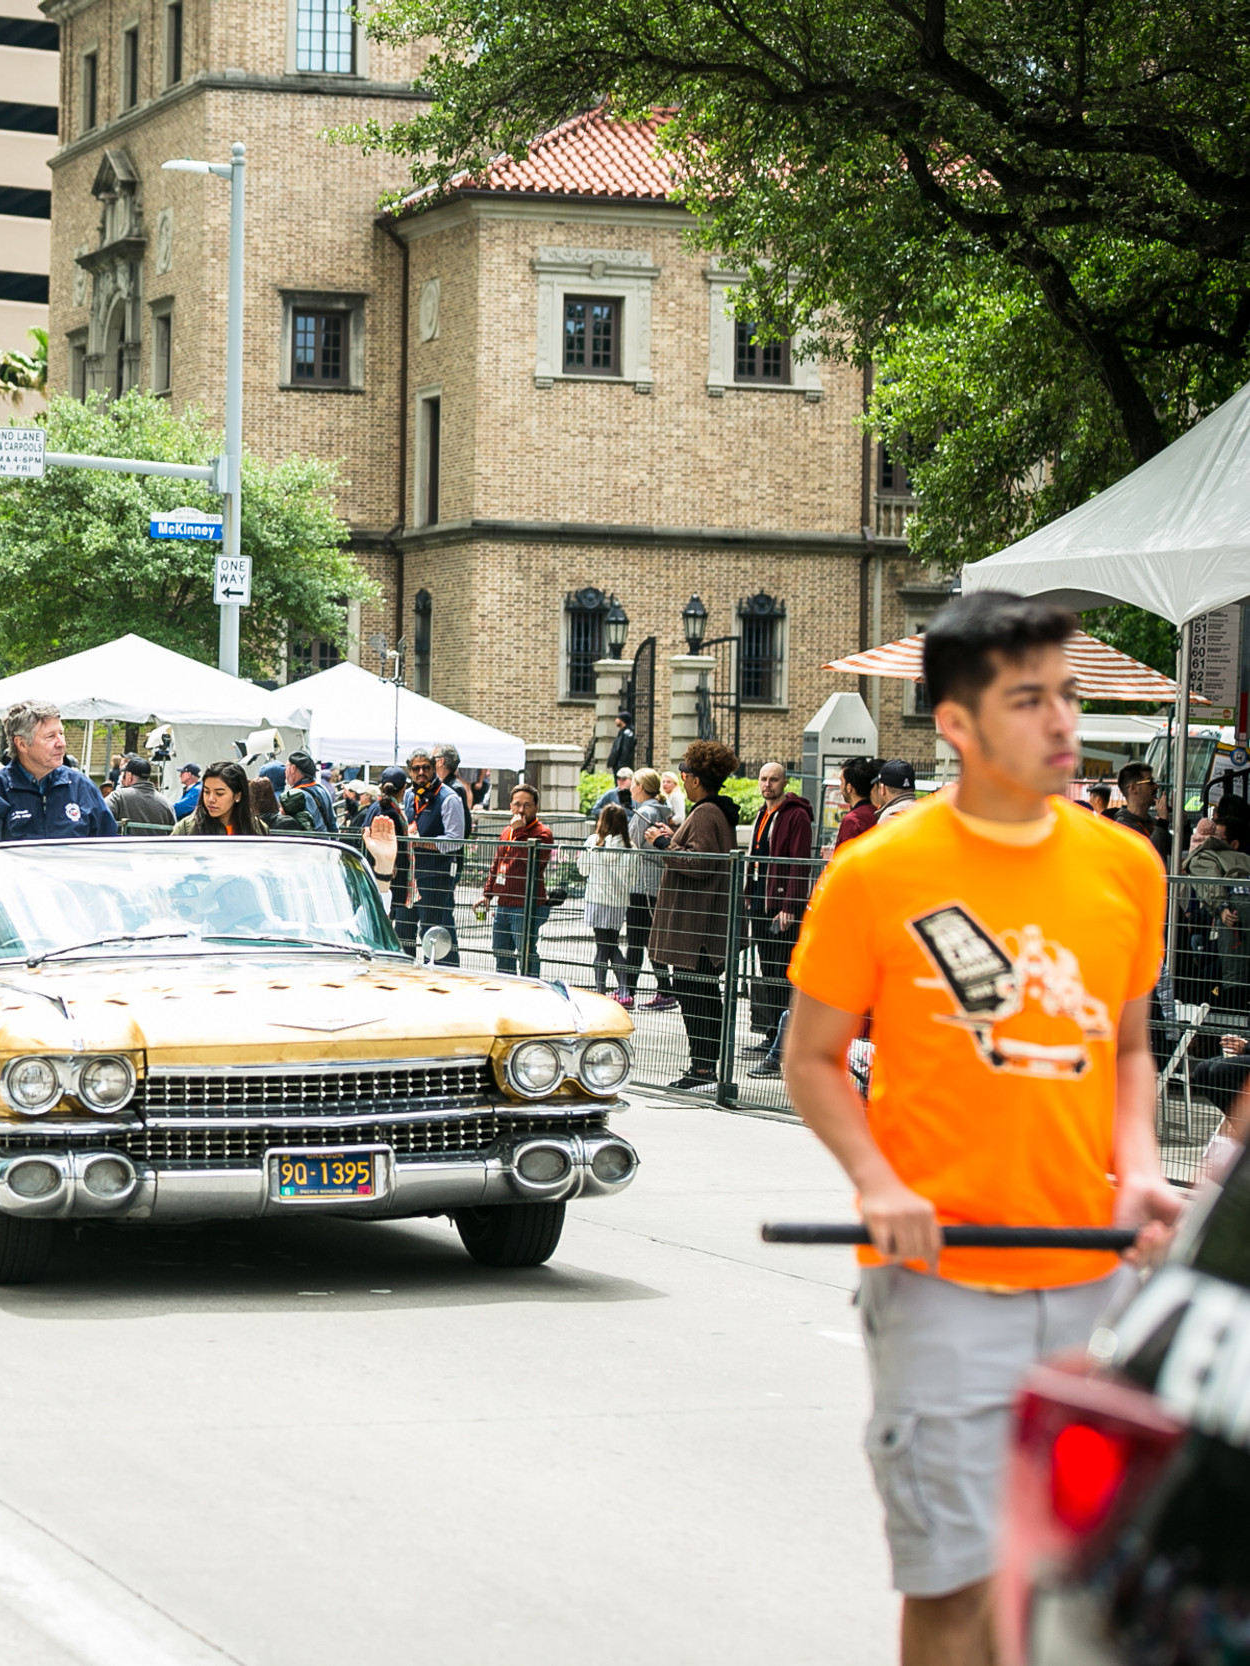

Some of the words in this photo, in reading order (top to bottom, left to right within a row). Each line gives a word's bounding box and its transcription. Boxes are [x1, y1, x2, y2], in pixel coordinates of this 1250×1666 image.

[18, 432, 40, 441] LANE
[0, 442, 3, 450] &
[4, 442, 42, 452] CARPOOLS
[16, 464, 31, 472] FRI
[158, 522, 215, 538] McKinney
[221, 560, 246, 571] ONE
[220, 573, 246, 584] WAY
